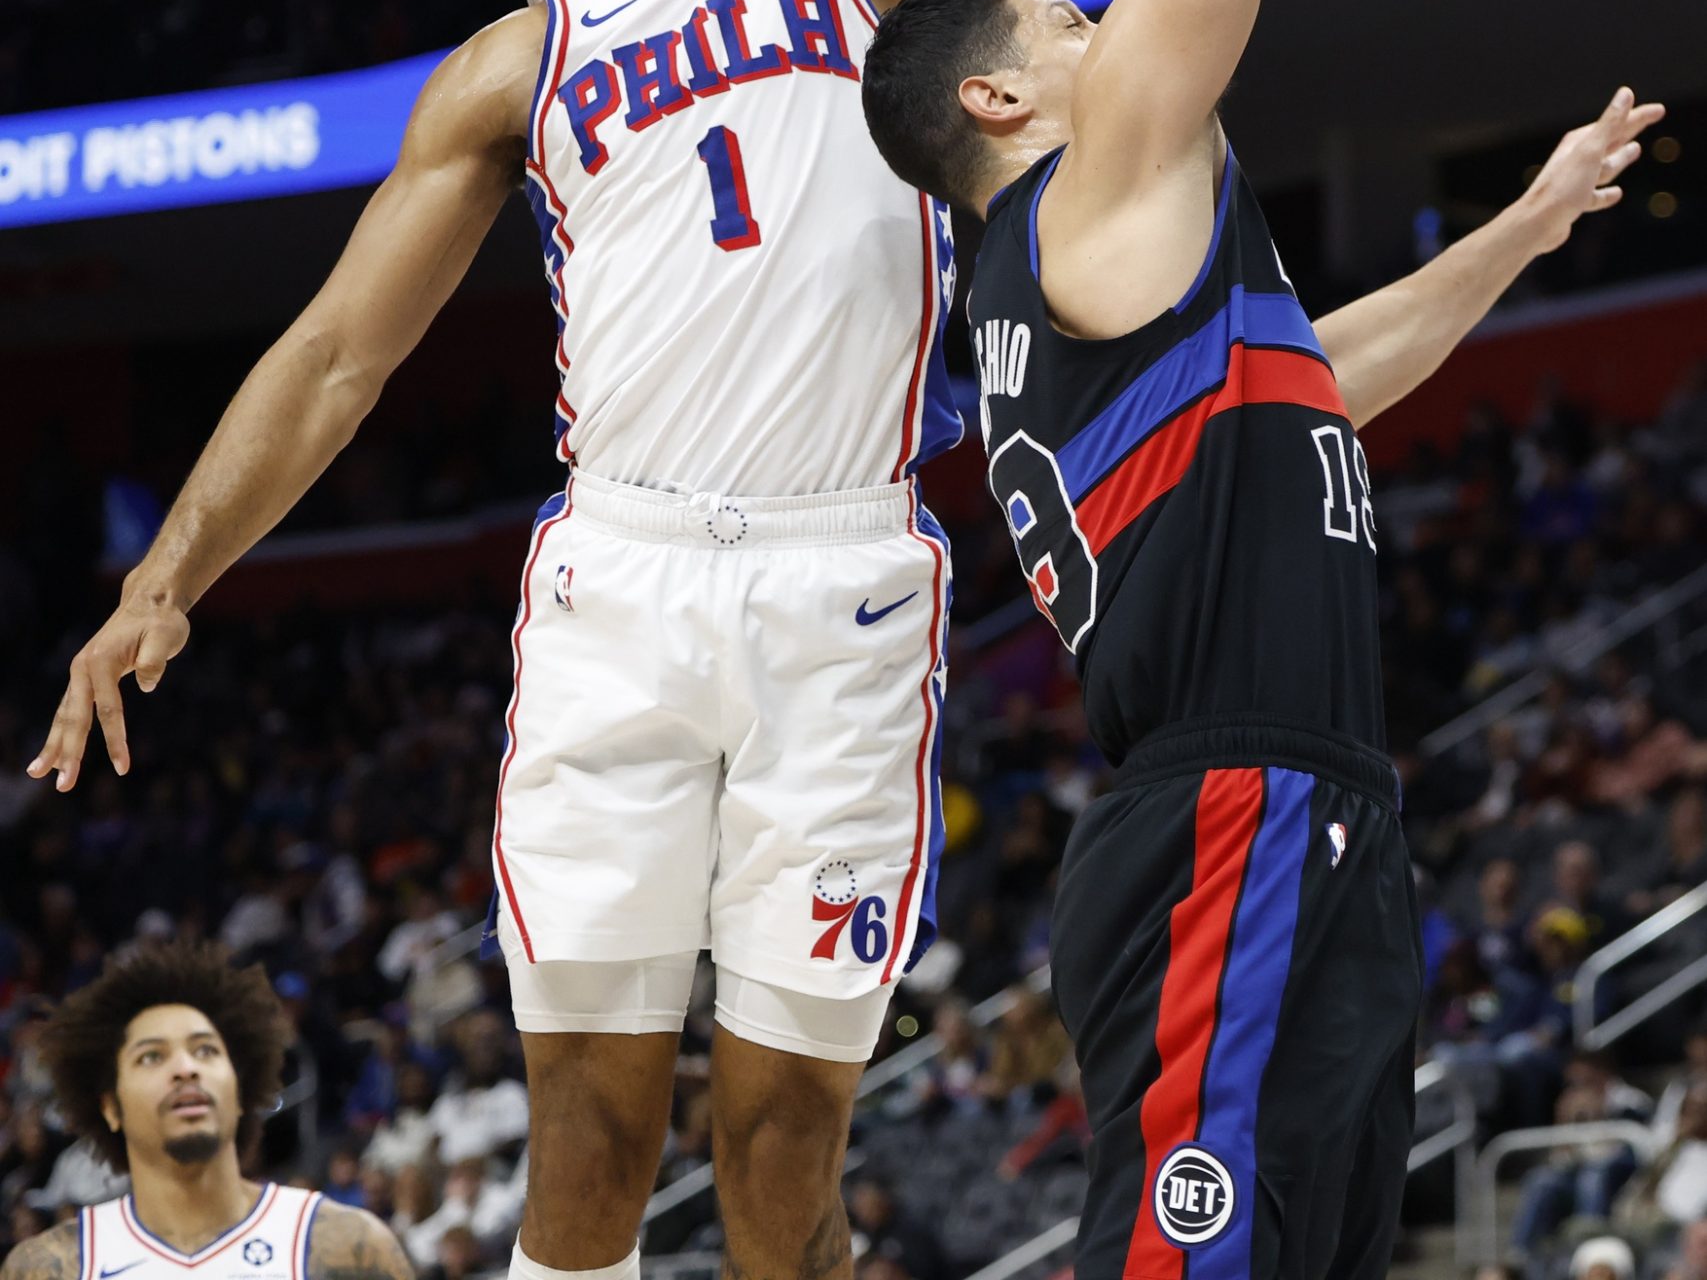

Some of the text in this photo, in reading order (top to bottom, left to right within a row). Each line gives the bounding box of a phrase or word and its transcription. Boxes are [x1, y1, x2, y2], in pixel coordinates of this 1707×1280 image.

[83, 101, 320, 194] PISTONS
[696, 124, 762, 252] 1
[810, 892, 889, 964] 76
[1168, 1175, 1220, 1216] DET
